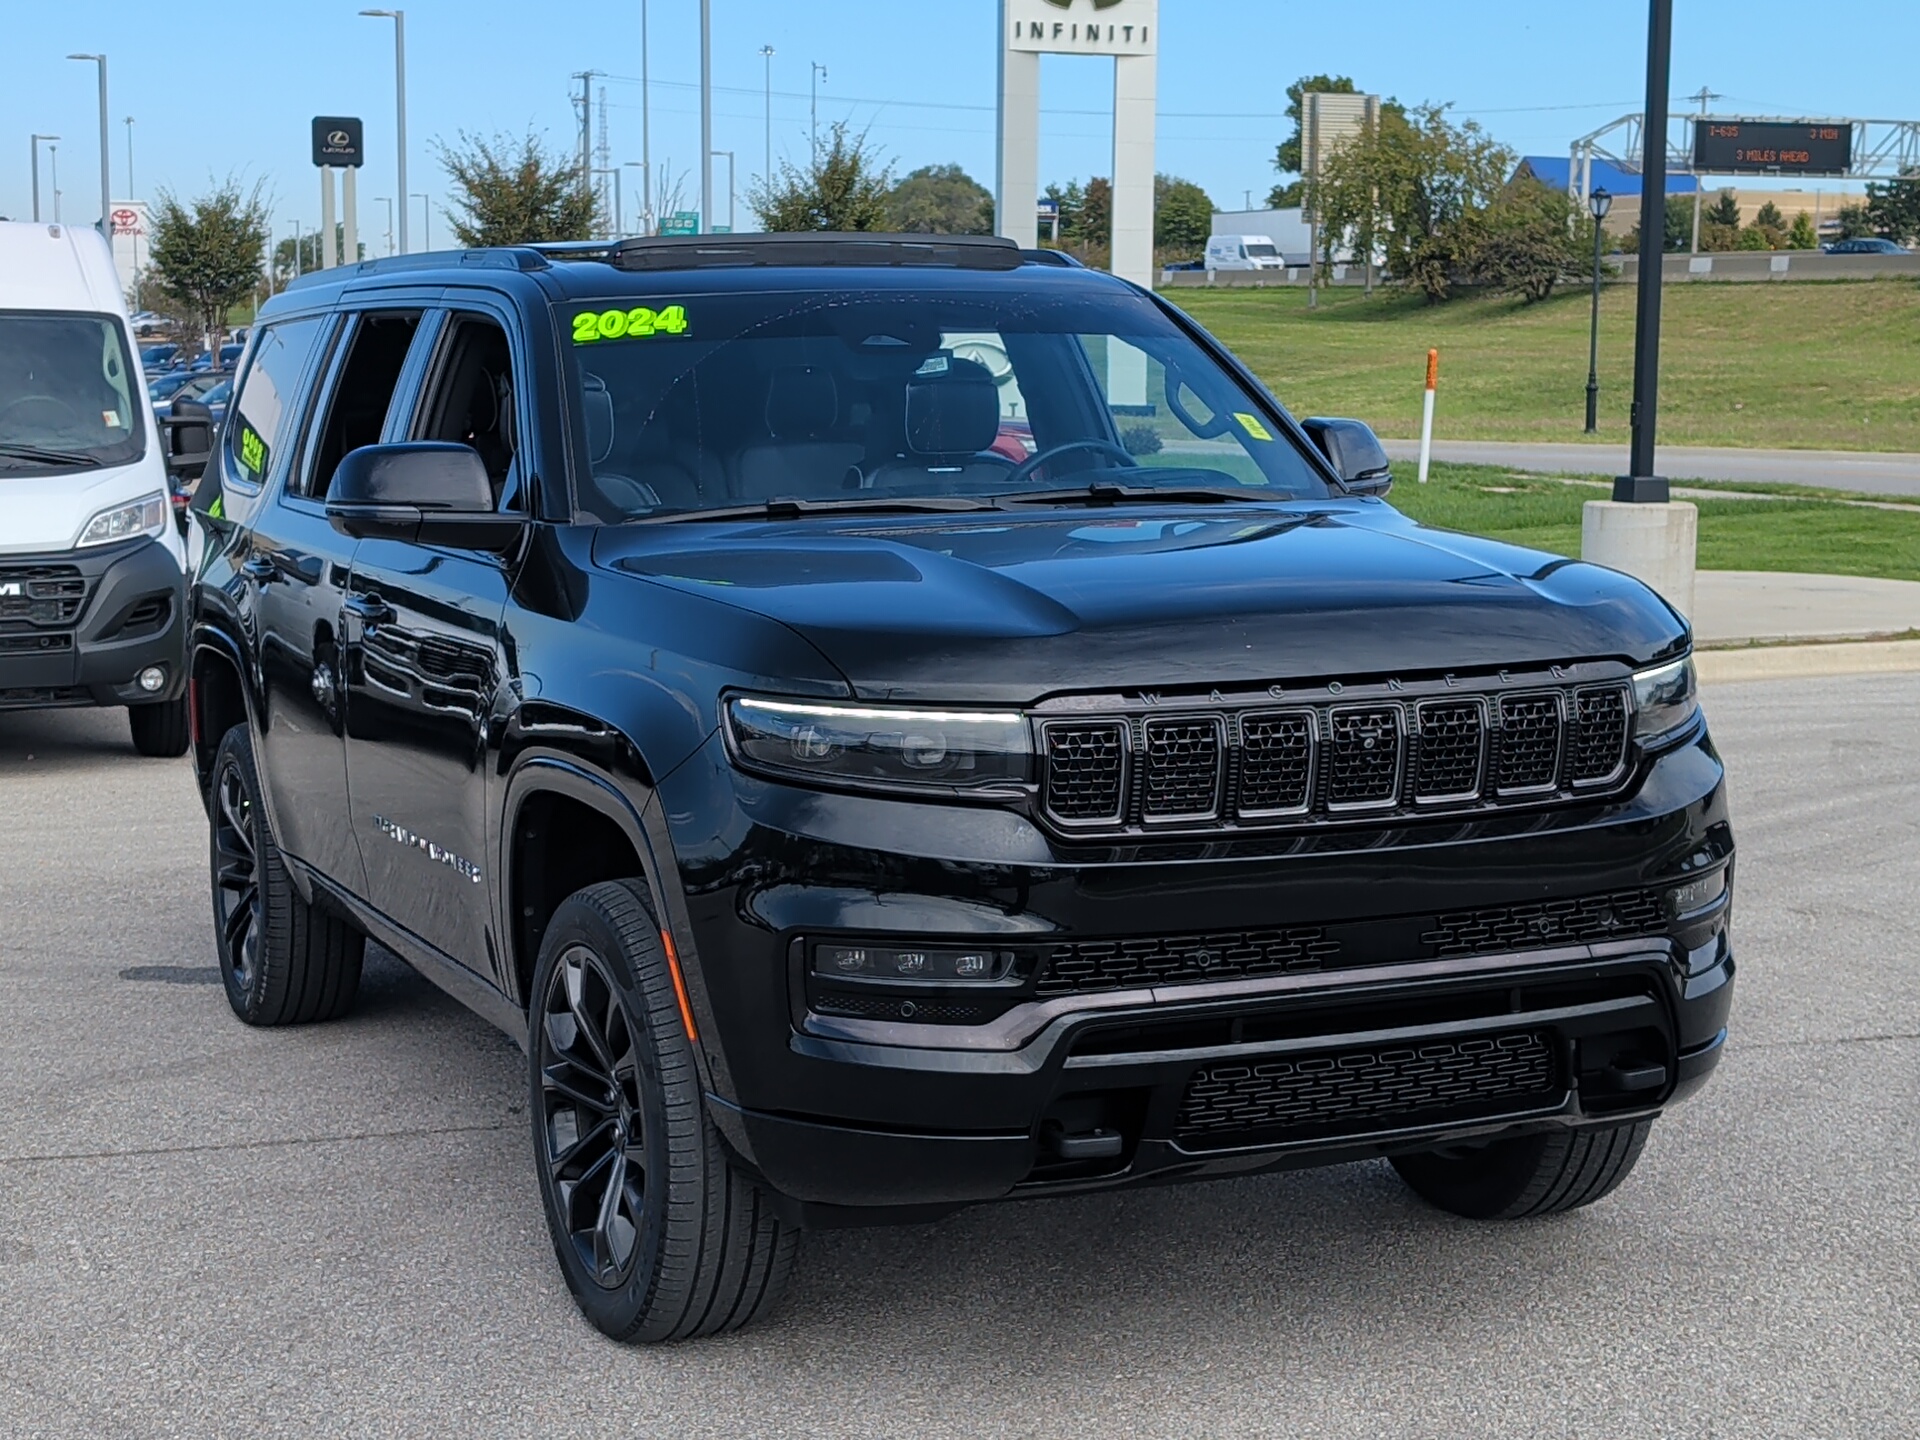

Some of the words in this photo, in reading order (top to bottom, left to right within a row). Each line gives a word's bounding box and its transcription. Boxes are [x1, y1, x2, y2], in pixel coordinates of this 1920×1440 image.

[1015, 20, 1148, 43] INFINITI
[1710, 125, 1739, 137] I-635
[1809, 128, 1817, 139] 3
[1736, 149, 1744, 160] 3
[1746, 149, 1776, 162] MILES
[1779, 151, 1810, 162] AHEAD
[572, 305, 687, 341] 2024
[1138, 664, 1567, 706] WAGONEER
